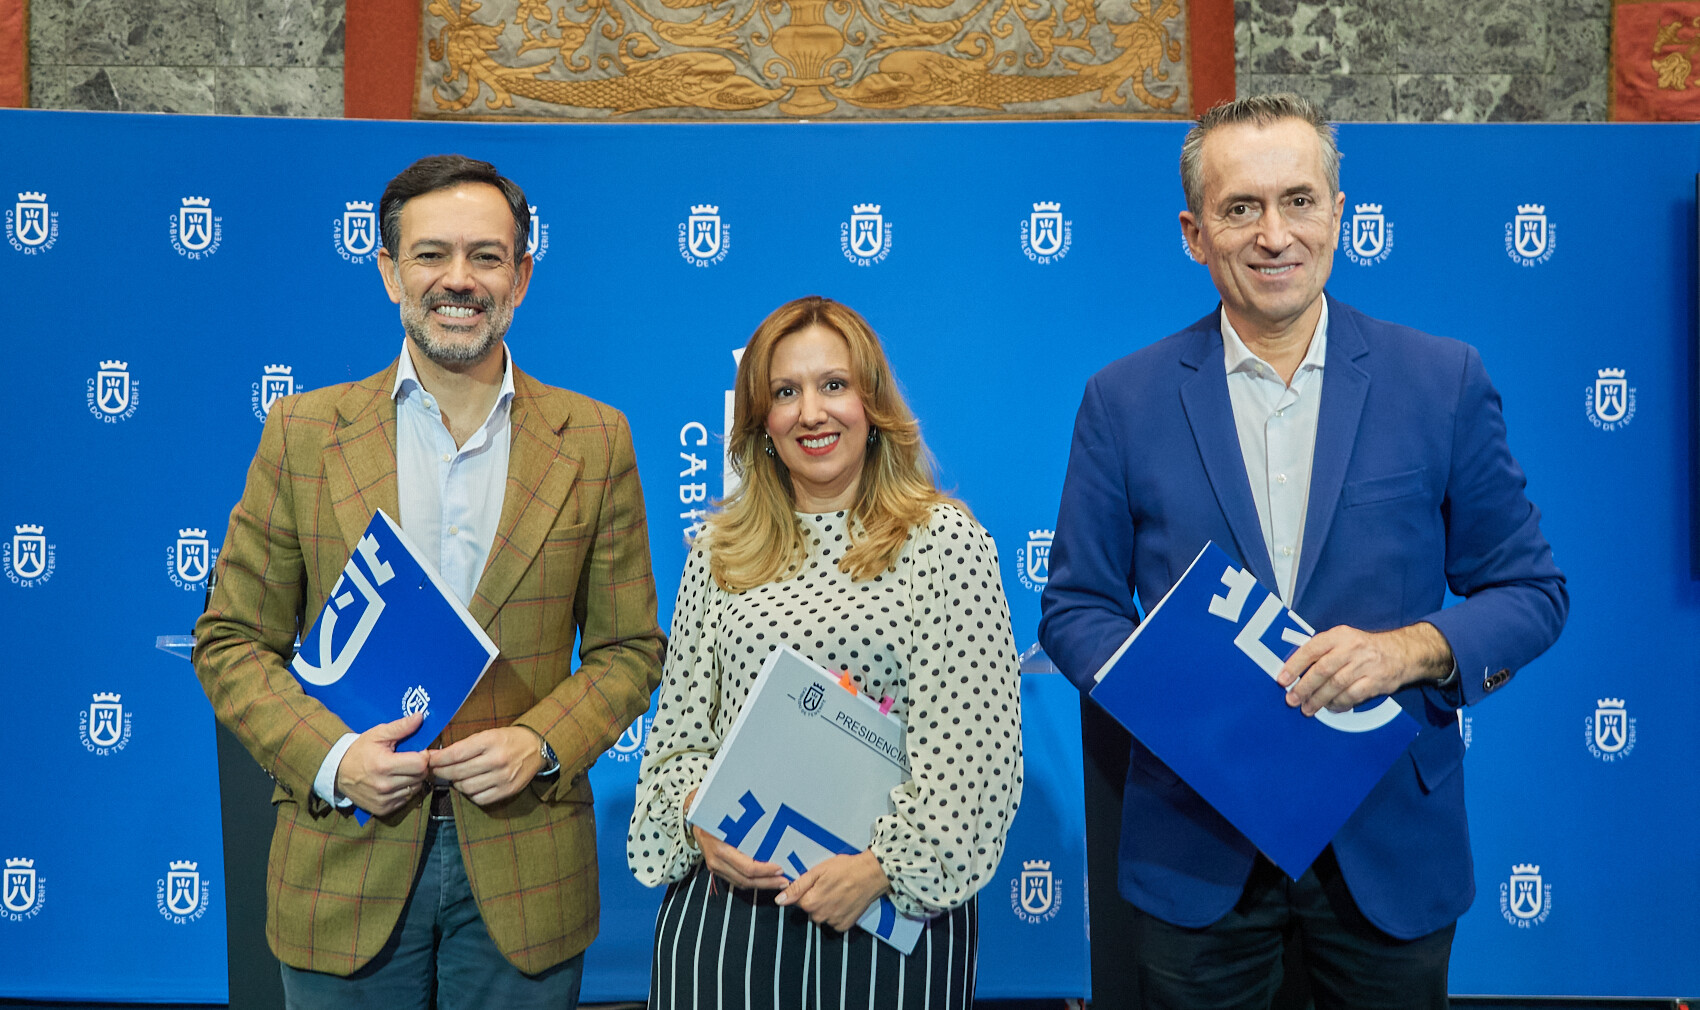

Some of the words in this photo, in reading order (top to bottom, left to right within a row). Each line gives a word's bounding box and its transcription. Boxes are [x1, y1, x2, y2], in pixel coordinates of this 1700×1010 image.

[5, 210, 23, 251] CABILDO
[24, 247, 36, 255] DE
[38, 211, 58, 253] TENERIFE
[169, 215, 187, 256] CABILDO
[188, 252, 200, 260] DE
[202, 216, 222, 258] TENERIFE
[333, 219, 351, 260] CABILDO
[352, 256, 364, 264] DE
[677, 223, 695, 264] CABILDO
[696, 260, 708, 268] DE
[710, 224, 730, 266] TENERIFE
[840, 221, 858, 262] CABILDO
[859, 258, 871, 266] DE
[873, 222, 893, 264] TENERIFE
[1020, 220, 1038, 261] CABILDO
[1039, 257, 1051, 265] DE
[1053, 221, 1073, 263] TENERIFE
[1342, 221, 1360, 262] CABILDO
[1361, 258, 1373, 266] DE
[1375, 222, 1395, 264] TENERIFE
[1504, 222, 1522, 263] CABILDO
[1523, 259, 1535, 267] DE
[1537, 223, 1557, 265] TENERIFE
[86, 378, 104, 419] CABILDO
[105, 415, 117, 423] DE
[119, 379, 139, 421] TENERIFE
[1585, 386, 1603, 427] CABILDO
[1604, 423, 1616, 431] DE
[3, 543, 21, 584] CABILDO
[22, 580, 34, 588] DE
[36, 544, 56, 586] TENERIFE
[166, 546, 184, 587] CABILDO
[185, 583, 197, 591] DE
[1016, 548, 1034, 589] CABILDO
[79, 711, 97, 752] CABILDO
[98, 748, 110, 756] DE
[112, 712, 132, 754] TENERIFE
[835, 710, 907, 766] PRESIDENCIA
[1584, 716, 1602, 757] CABILDO
[1603, 753, 1615, 761] DE
[617, 754, 630, 762] DE
[12, 913, 24, 921] DE
[26, 877, 46, 919] TENERIFE
[156, 879, 174, 920] CABILDO
[175, 916, 187, 924] DE
[189, 880, 209, 922] TENERIFE
[1010, 878, 1028, 919] CABILDO
[1029, 915, 1041, 923] DE
[1499, 883, 1517, 924] CABILDO
[1518, 920, 1530, 928] DE
